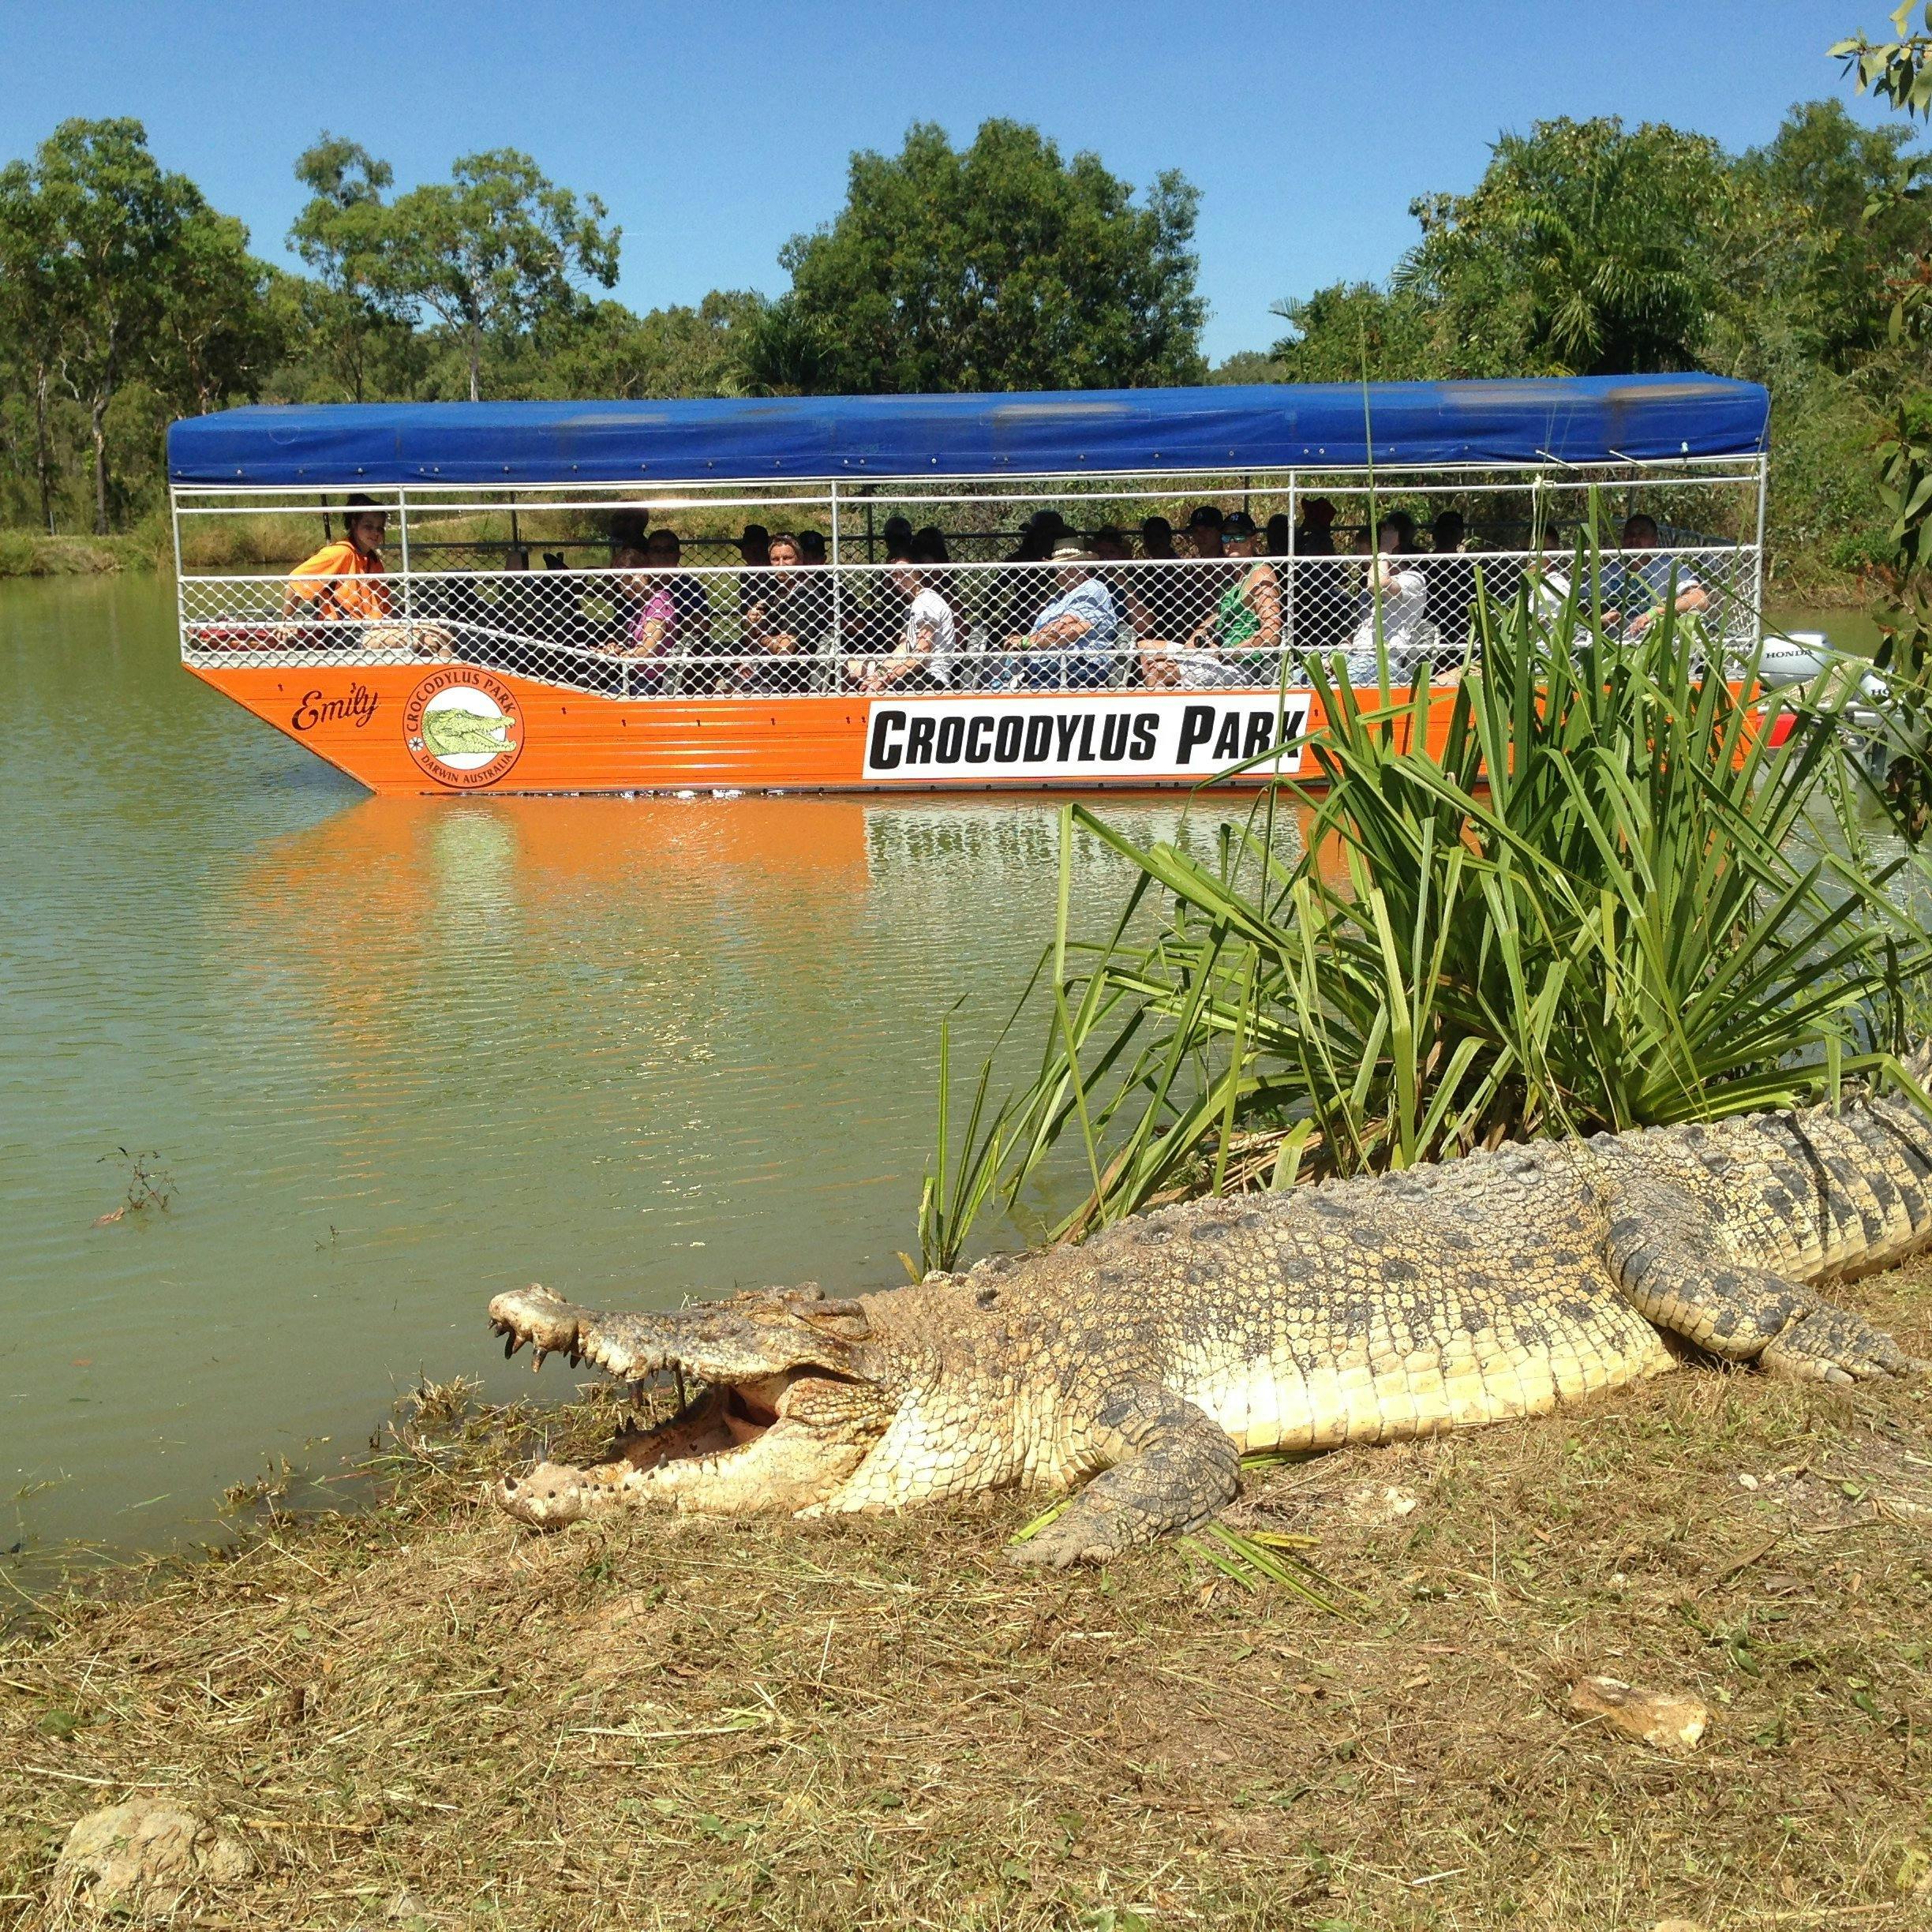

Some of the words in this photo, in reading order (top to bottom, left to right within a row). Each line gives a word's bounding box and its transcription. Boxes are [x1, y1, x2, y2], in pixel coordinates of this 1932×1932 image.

[1765, 649, 1814, 659] HONDA
[291, 683, 379, 732] Emily
[406, 671, 480, 732] CROCODYLUS
[485, 679, 516, 713] PARK
[869, 710, 1160, 770] CROCODYLUS
[1175, 705, 1305, 765] PARK
[421, 754, 459, 784] DARWIN
[462, 753, 514, 784] AUSTRALIA
